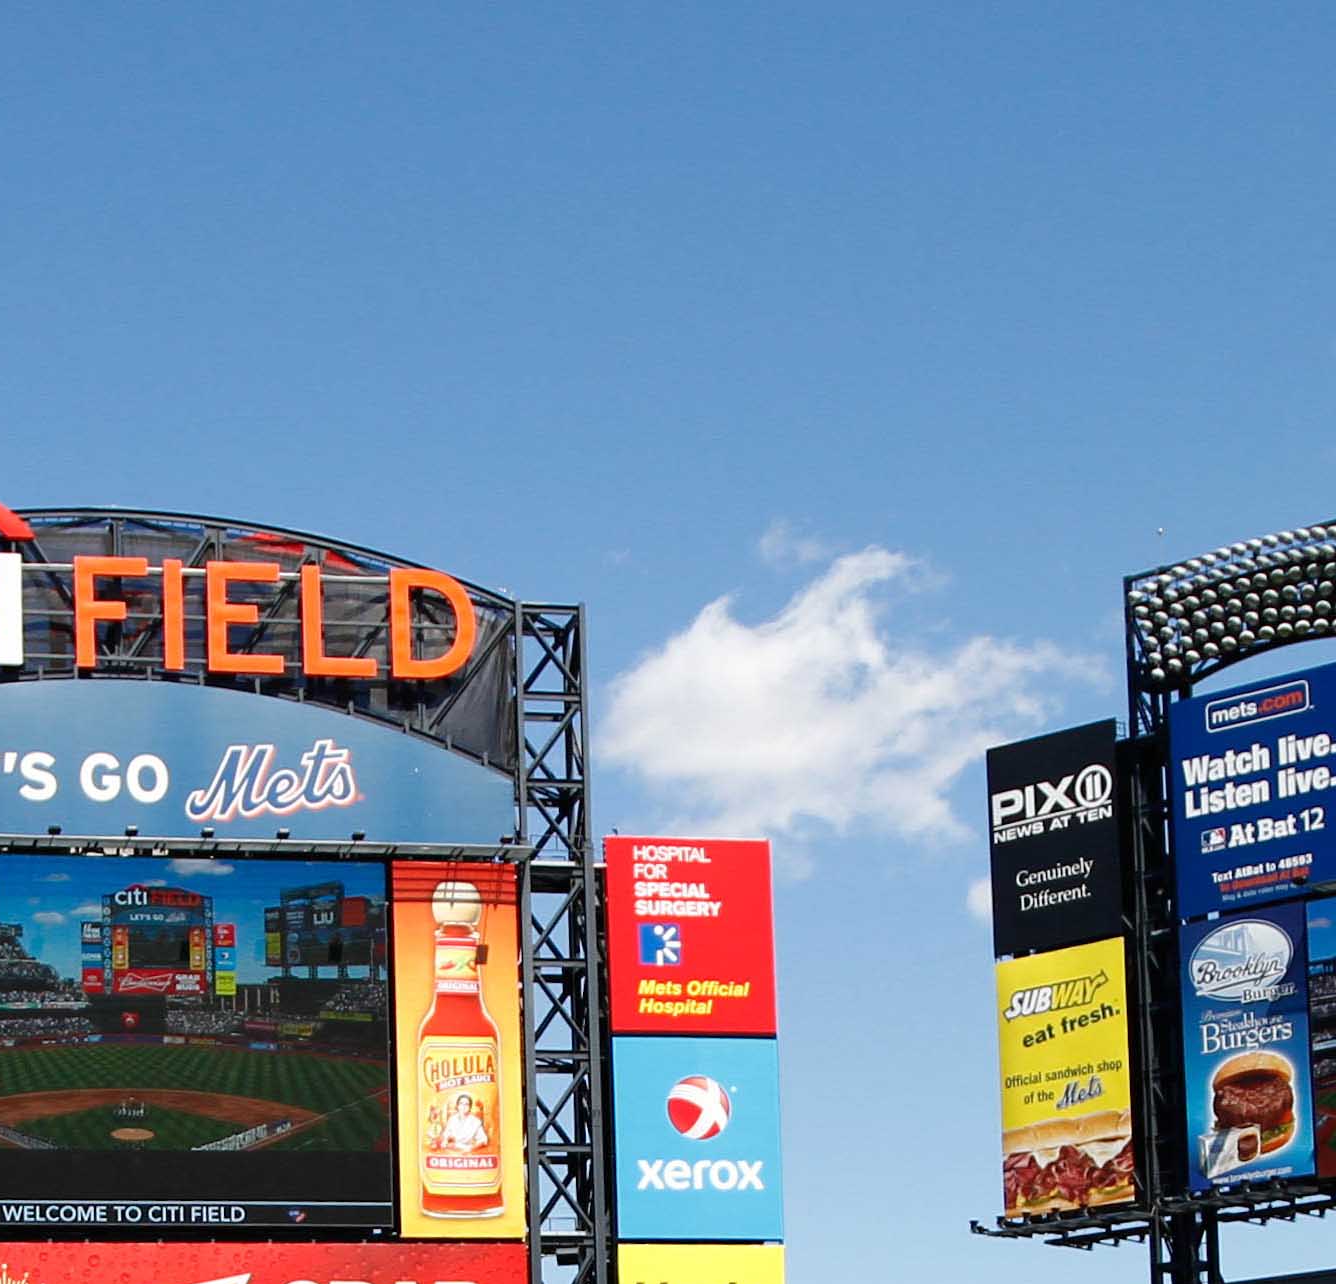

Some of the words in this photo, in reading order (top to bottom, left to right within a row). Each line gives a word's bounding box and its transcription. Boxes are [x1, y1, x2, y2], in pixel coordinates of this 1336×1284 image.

[73, 555, 477, 678] FIELD
[1212, 690, 1303, 724] mets.com
[80, 753, 168, 803] GO
[185, 739, 355, 821] Mets
[1182, 744, 1270, 786] Watch
[992, 774, 1076, 826] PIX
[1185, 779, 1270, 819] Listen
[994, 821, 1044, 844] NEWS
[1050, 815, 1071, 831] AT
[1076, 805, 1112, 824] TEN
[1228, 823, 1256, 848] At
[1257, 814, 1297, 842] Bat
[1300, 807, 1324, 832] 12
[633, 845, 711, 863] HOSPITAL
[634, 863, 667, 879] FOR
[1016, 857, 1094, 887] Genuinely
[634, 881, 710, 898] SPECIAL
[1020, 883, 1092, 911] Different.
[635, 900, 722, 917] SURGERY
[1197, 951, 1287, 985] Brooklyn
[639, 980, 682, 997] Mets
[686, 980, 750, 998] Official
[1003, 970, 1108, 1022] SUBWAY
[639, 998, 712, 1016] Hospital
[1023, 1024, 1055, 1048] eat
[1061, 1004, 1120, 1033] fresh.
[1201, 1023, 1293, 1055] Burgers
[423, 1055, 495, 1089] CHOLULA
[1005, 1072, 1042, 1089] Official
[1045, 1064, 1094, 1082] sandwich
[1097, 1060, 1122, 1073] shop
[1024, 1092, 1036, 1104] of
[1037, 1090, 1054, 1101] the
[1056, 1075, 1103, 1110] Mets
[429, 1157, 494, 1169] ORIGINAL
[636, 1159, 765, 1190] xerox
[3, 1205, 107, 1222] WELCOME
[113, 1205, 142, 1222] TO
[148, 1205, 185, 1222] CITI
[190, 1205, 246, 1223] FIELD
